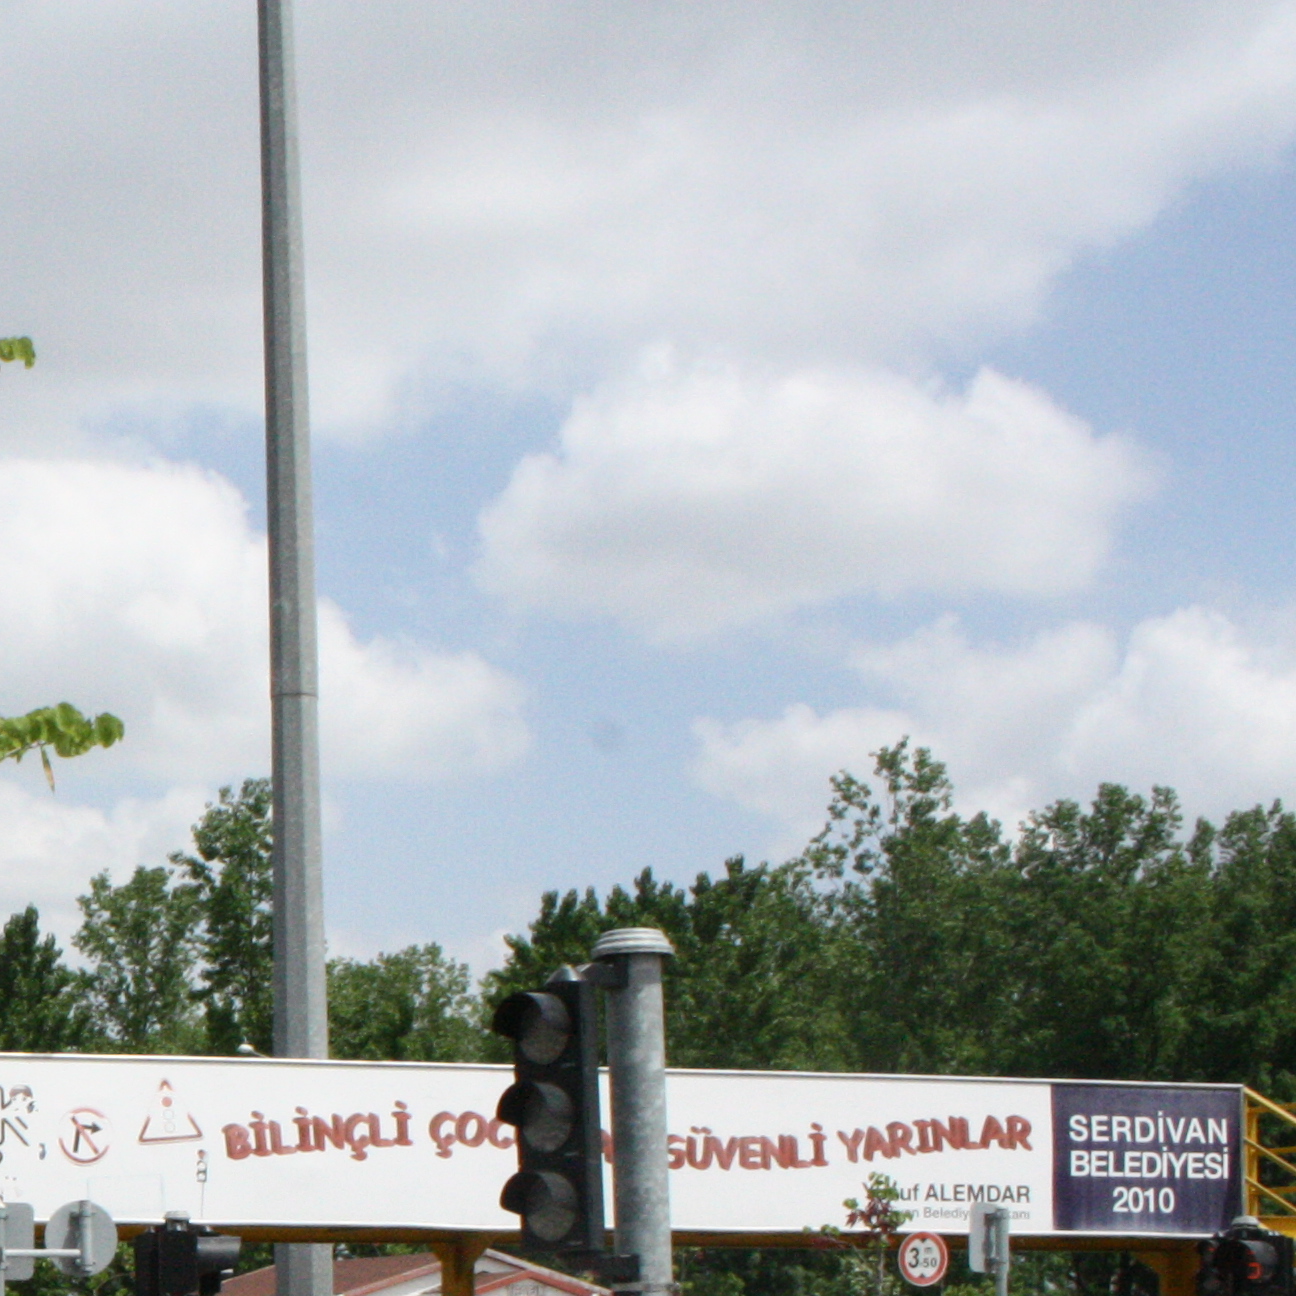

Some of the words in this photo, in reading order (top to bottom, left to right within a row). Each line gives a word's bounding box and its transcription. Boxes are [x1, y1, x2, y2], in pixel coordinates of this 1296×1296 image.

[221, 1100, 414, 1161] BİLİNÇLİ
[837, 1115, 1034, 1164] YARINLAR
[1068, 1110, 1228, 1144] SERDİVAN
[1069, 1146, 1230, 1179] BELEDİYESİ
[924, 1183, 1031, 1203] ALEMDAR
[1112, 1186, 1175, 1214] 2010
